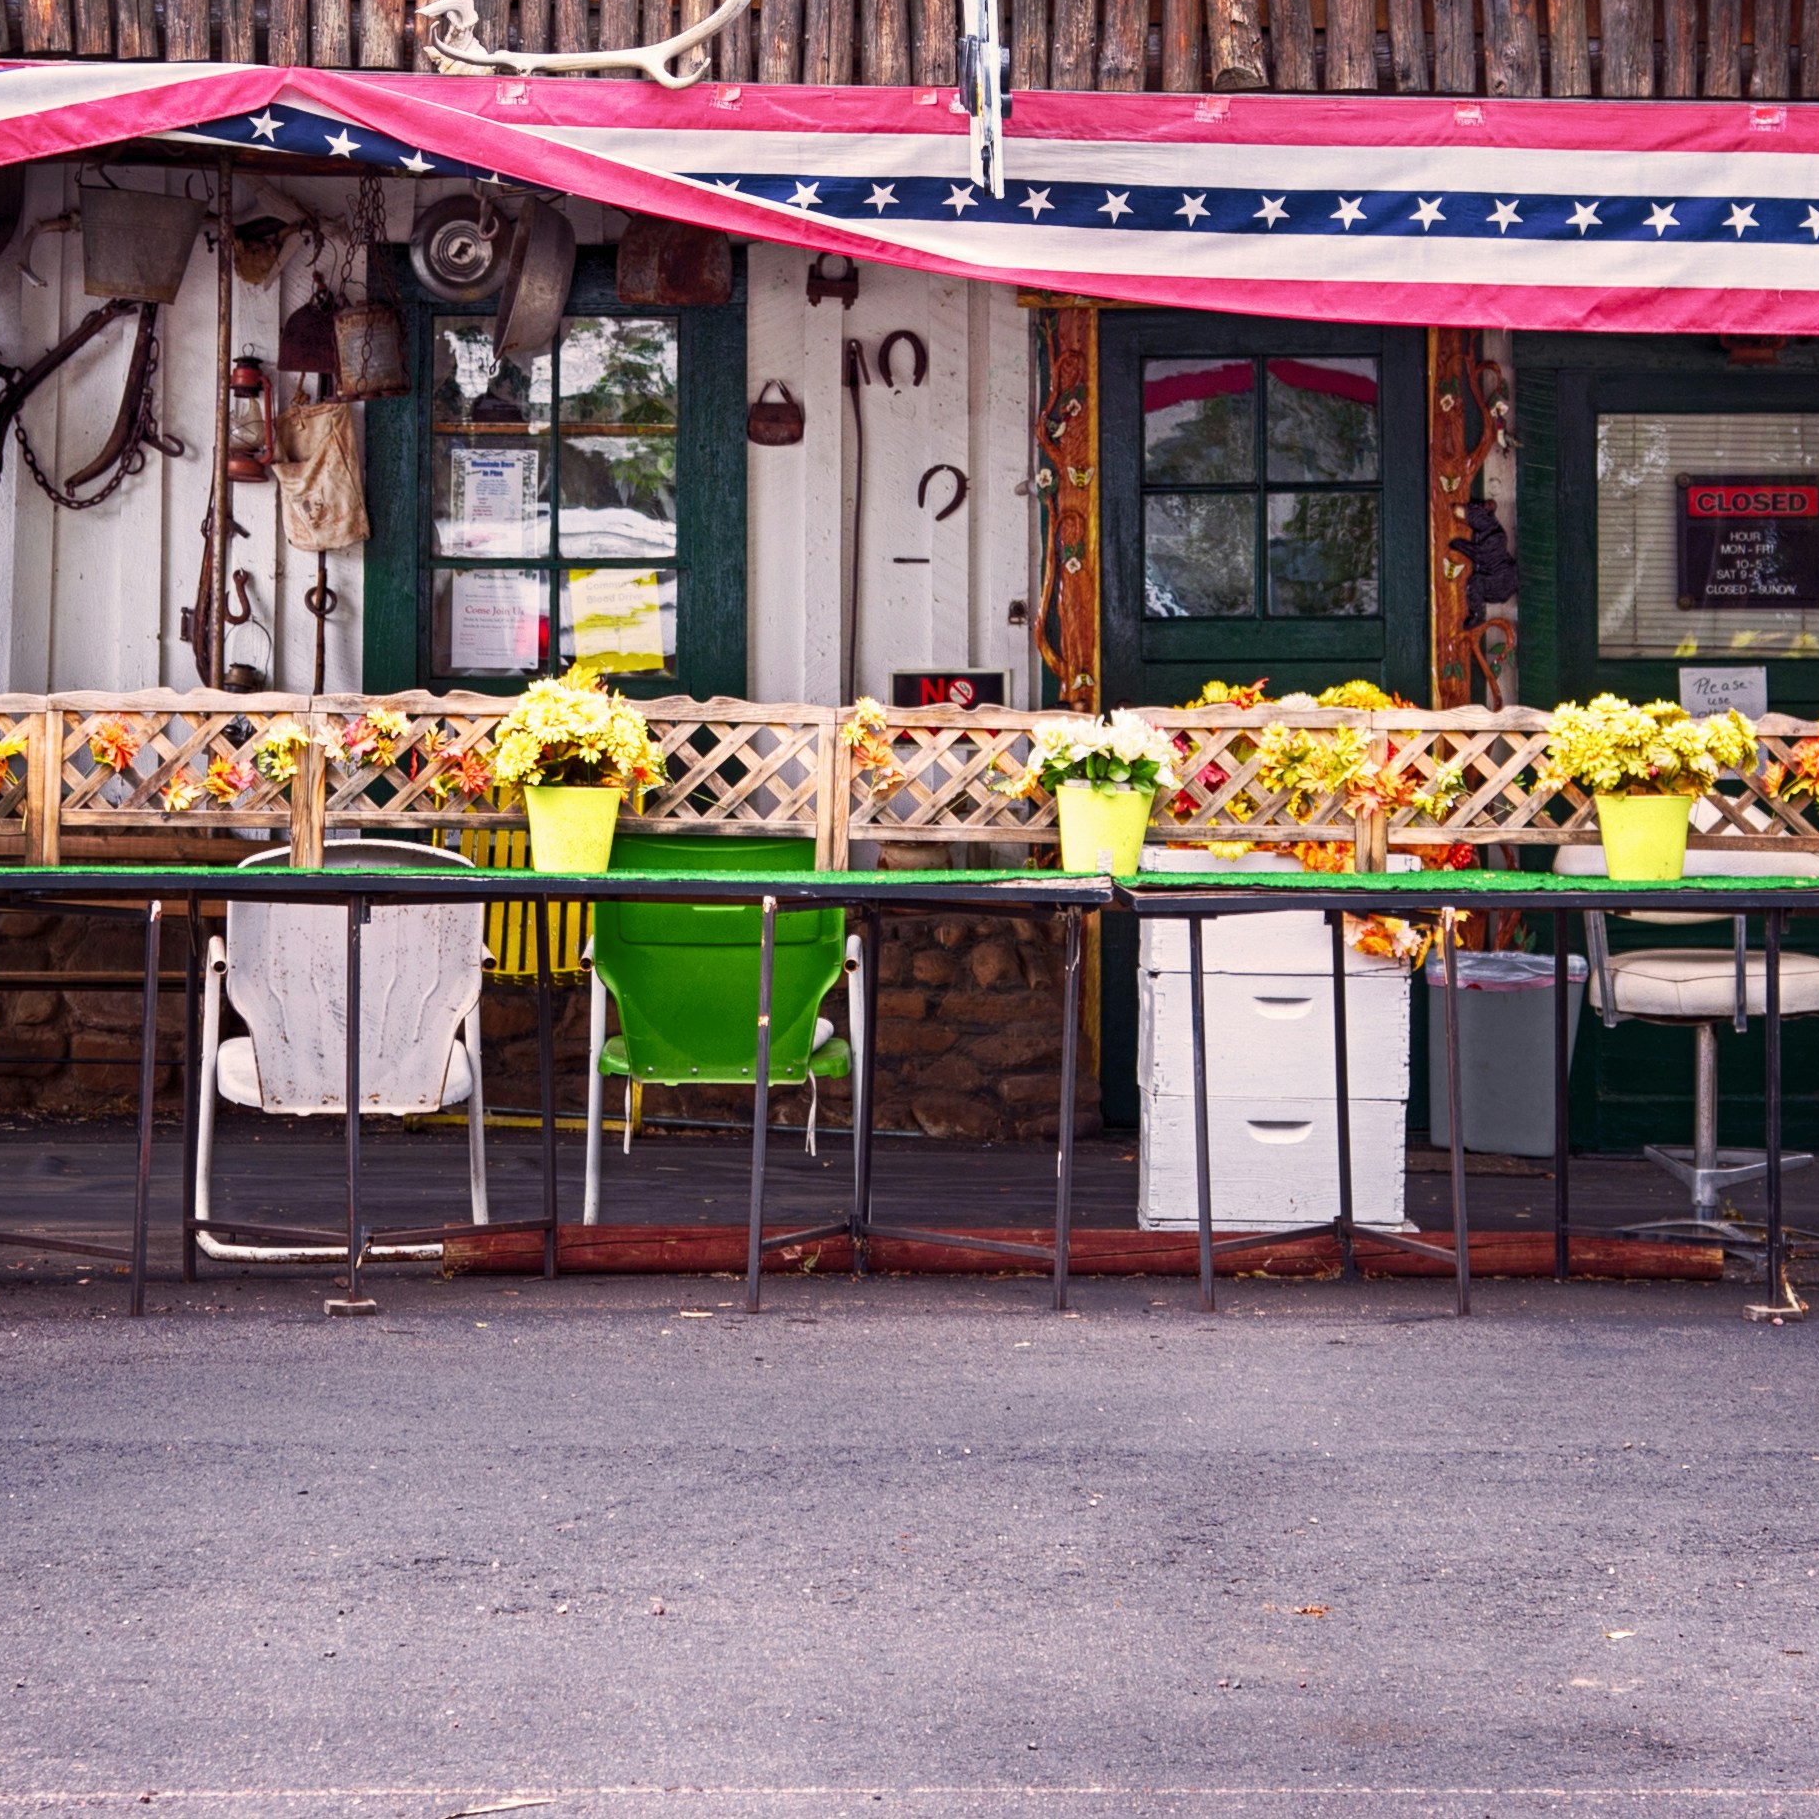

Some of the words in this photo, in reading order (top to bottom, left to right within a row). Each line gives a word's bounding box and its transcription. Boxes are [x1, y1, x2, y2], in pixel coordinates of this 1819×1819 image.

[1696, 492, 1807, 512] CLOSED
[1730, 531, 1761, 542] HOUR
[1720, 544, 1746, 555] MON
[1755, 544, 1775, 555] FRI
[1716, 570, 1736, 580] SAT
[1705, 584, 1748, 595] CLOSED
[1757, 584, 1797, 595] SUNDAY
[464, 605, 491, 615] Come
[492, 605, 510, 617] Join
[1693, 677, 1749, 696] Please
[1707, 696, 1732, 706] use
